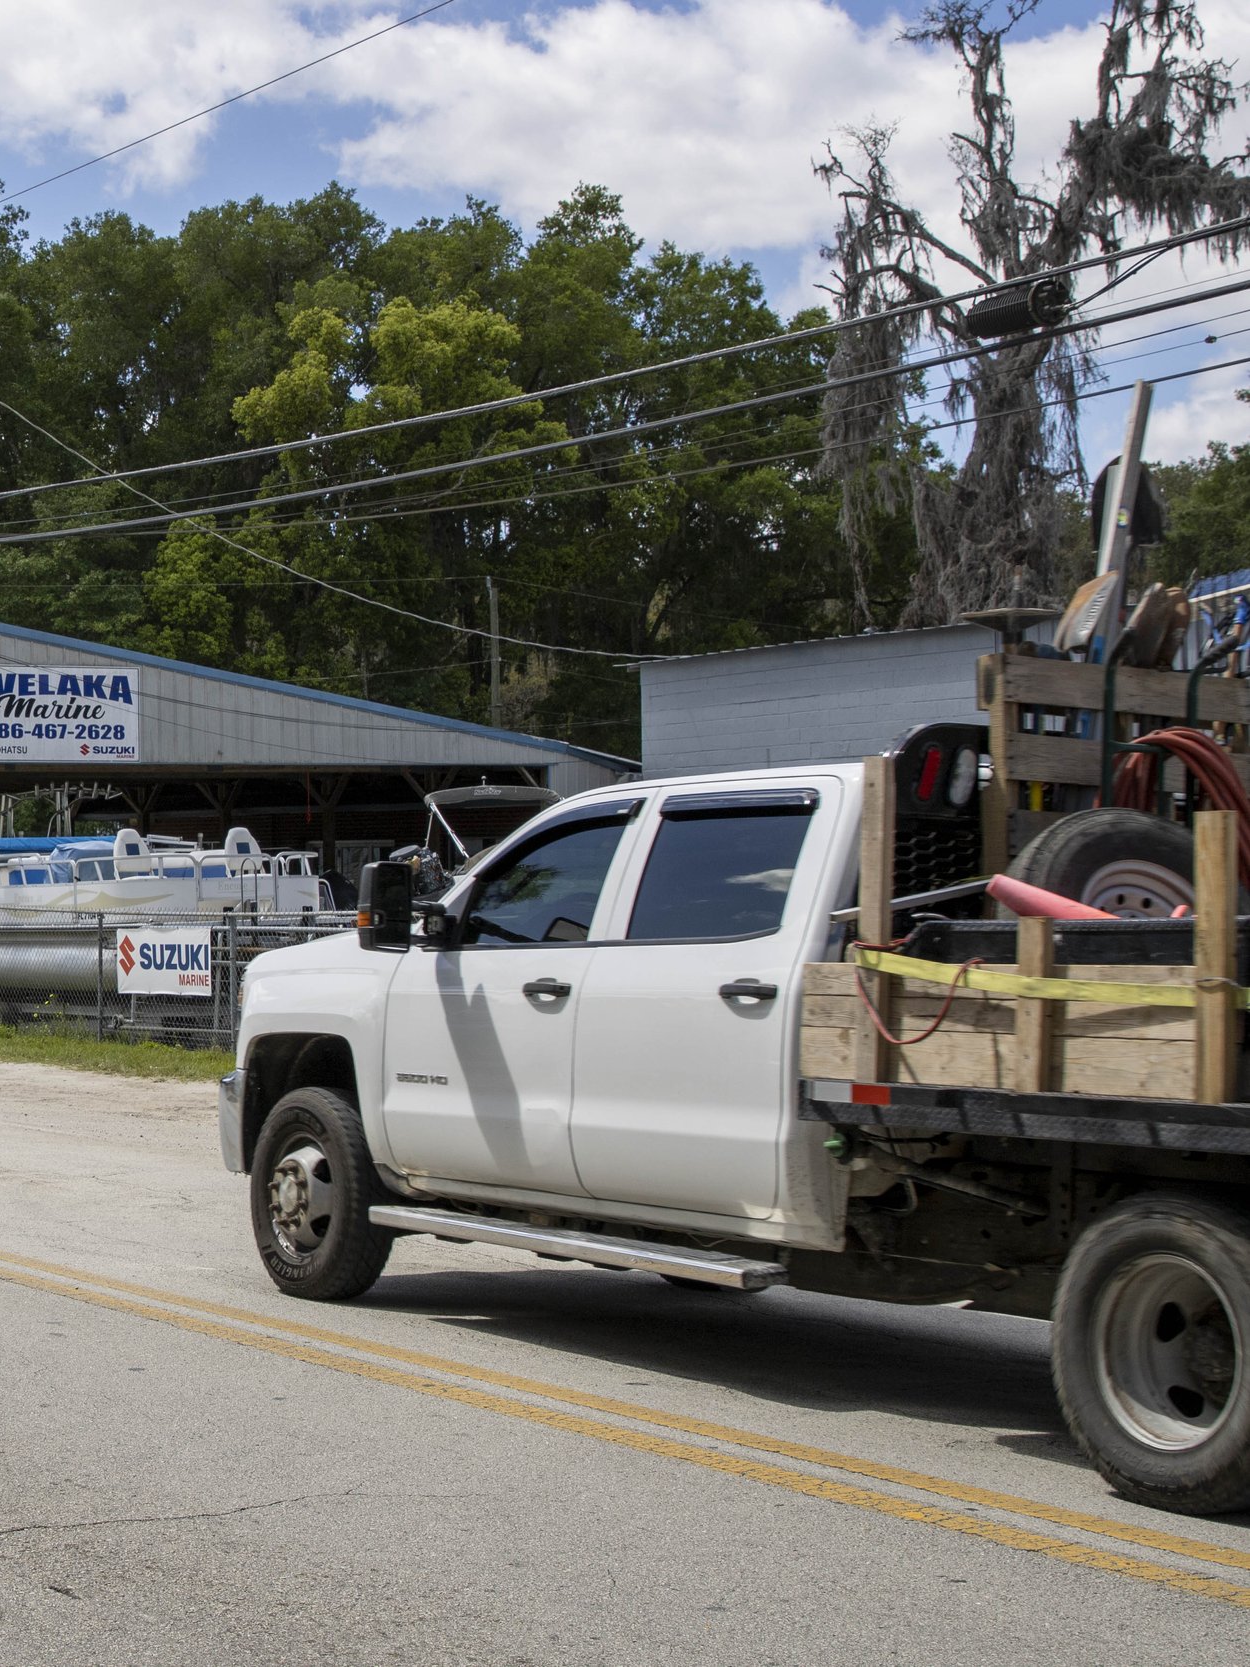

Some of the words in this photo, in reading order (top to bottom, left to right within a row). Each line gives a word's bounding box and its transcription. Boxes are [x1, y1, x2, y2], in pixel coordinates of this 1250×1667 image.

[92, 745, 135, 755] SUZUKI
[217, 880, 248, 891] Encoe
[139, 942, 209, 971] SUZUKI
[178, 973, 210, 987] MARINE
